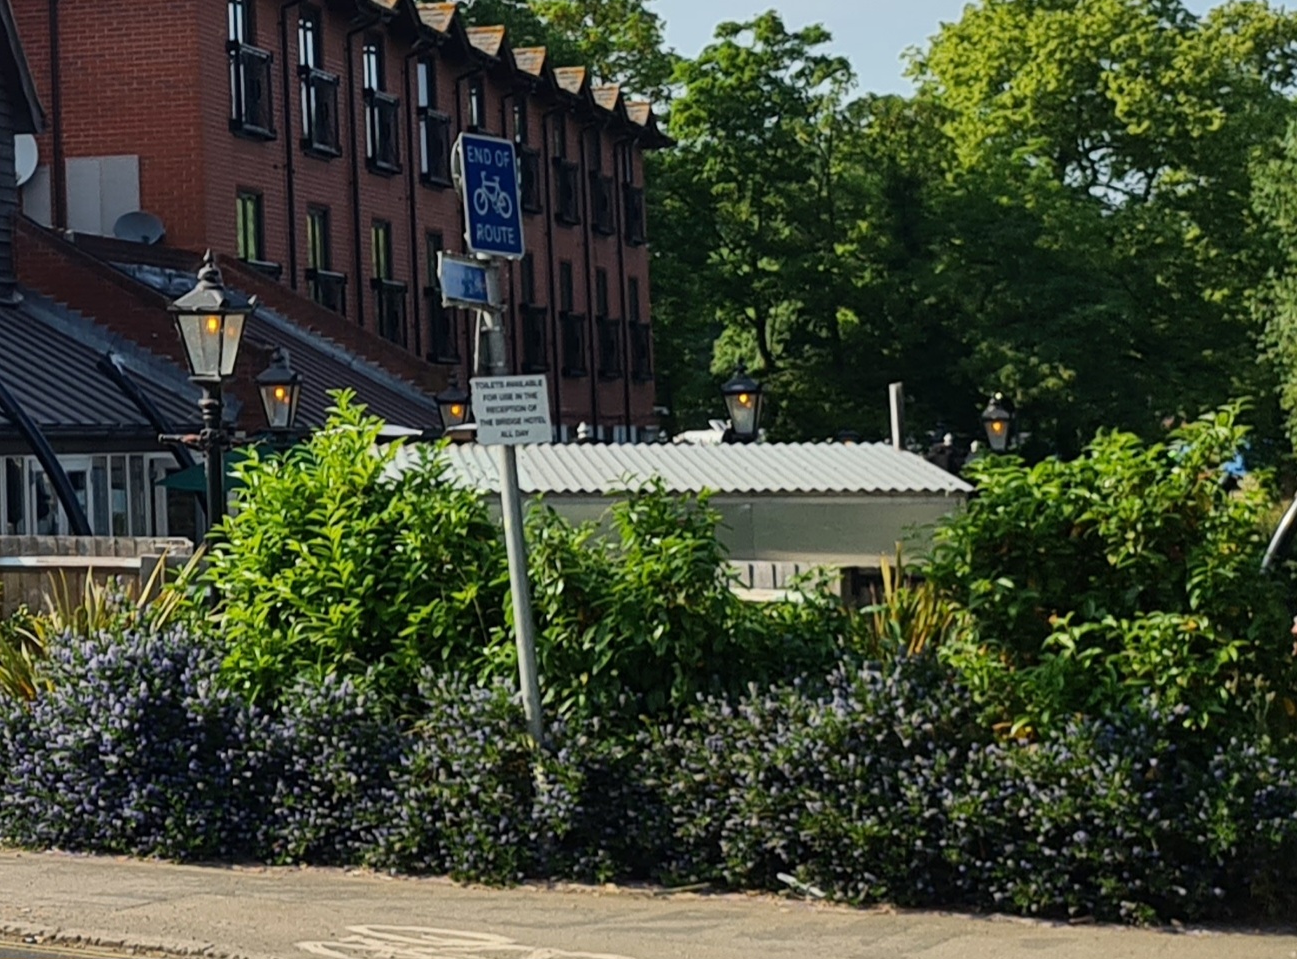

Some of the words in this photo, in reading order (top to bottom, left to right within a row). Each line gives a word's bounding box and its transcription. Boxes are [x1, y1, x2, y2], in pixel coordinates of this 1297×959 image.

[466, 145, 492, 166] END
[495, 149, 510, 168] OF
[476, 223, 515, 245] ROUTE
[483, 393, 497, 401] FOR
[499, 393, 513, 401] USE
[515, 392, 522, 400] IN
[524, 391, 538, 399] THE
[486, 405, 526, 413] RECEPTION
[479, 418, 493, 427] THE
[495, 417, 521, 426] BRIDGE
[523, 415, 546, 424] HOTEL
[515, 429, 529, 437] DAY
